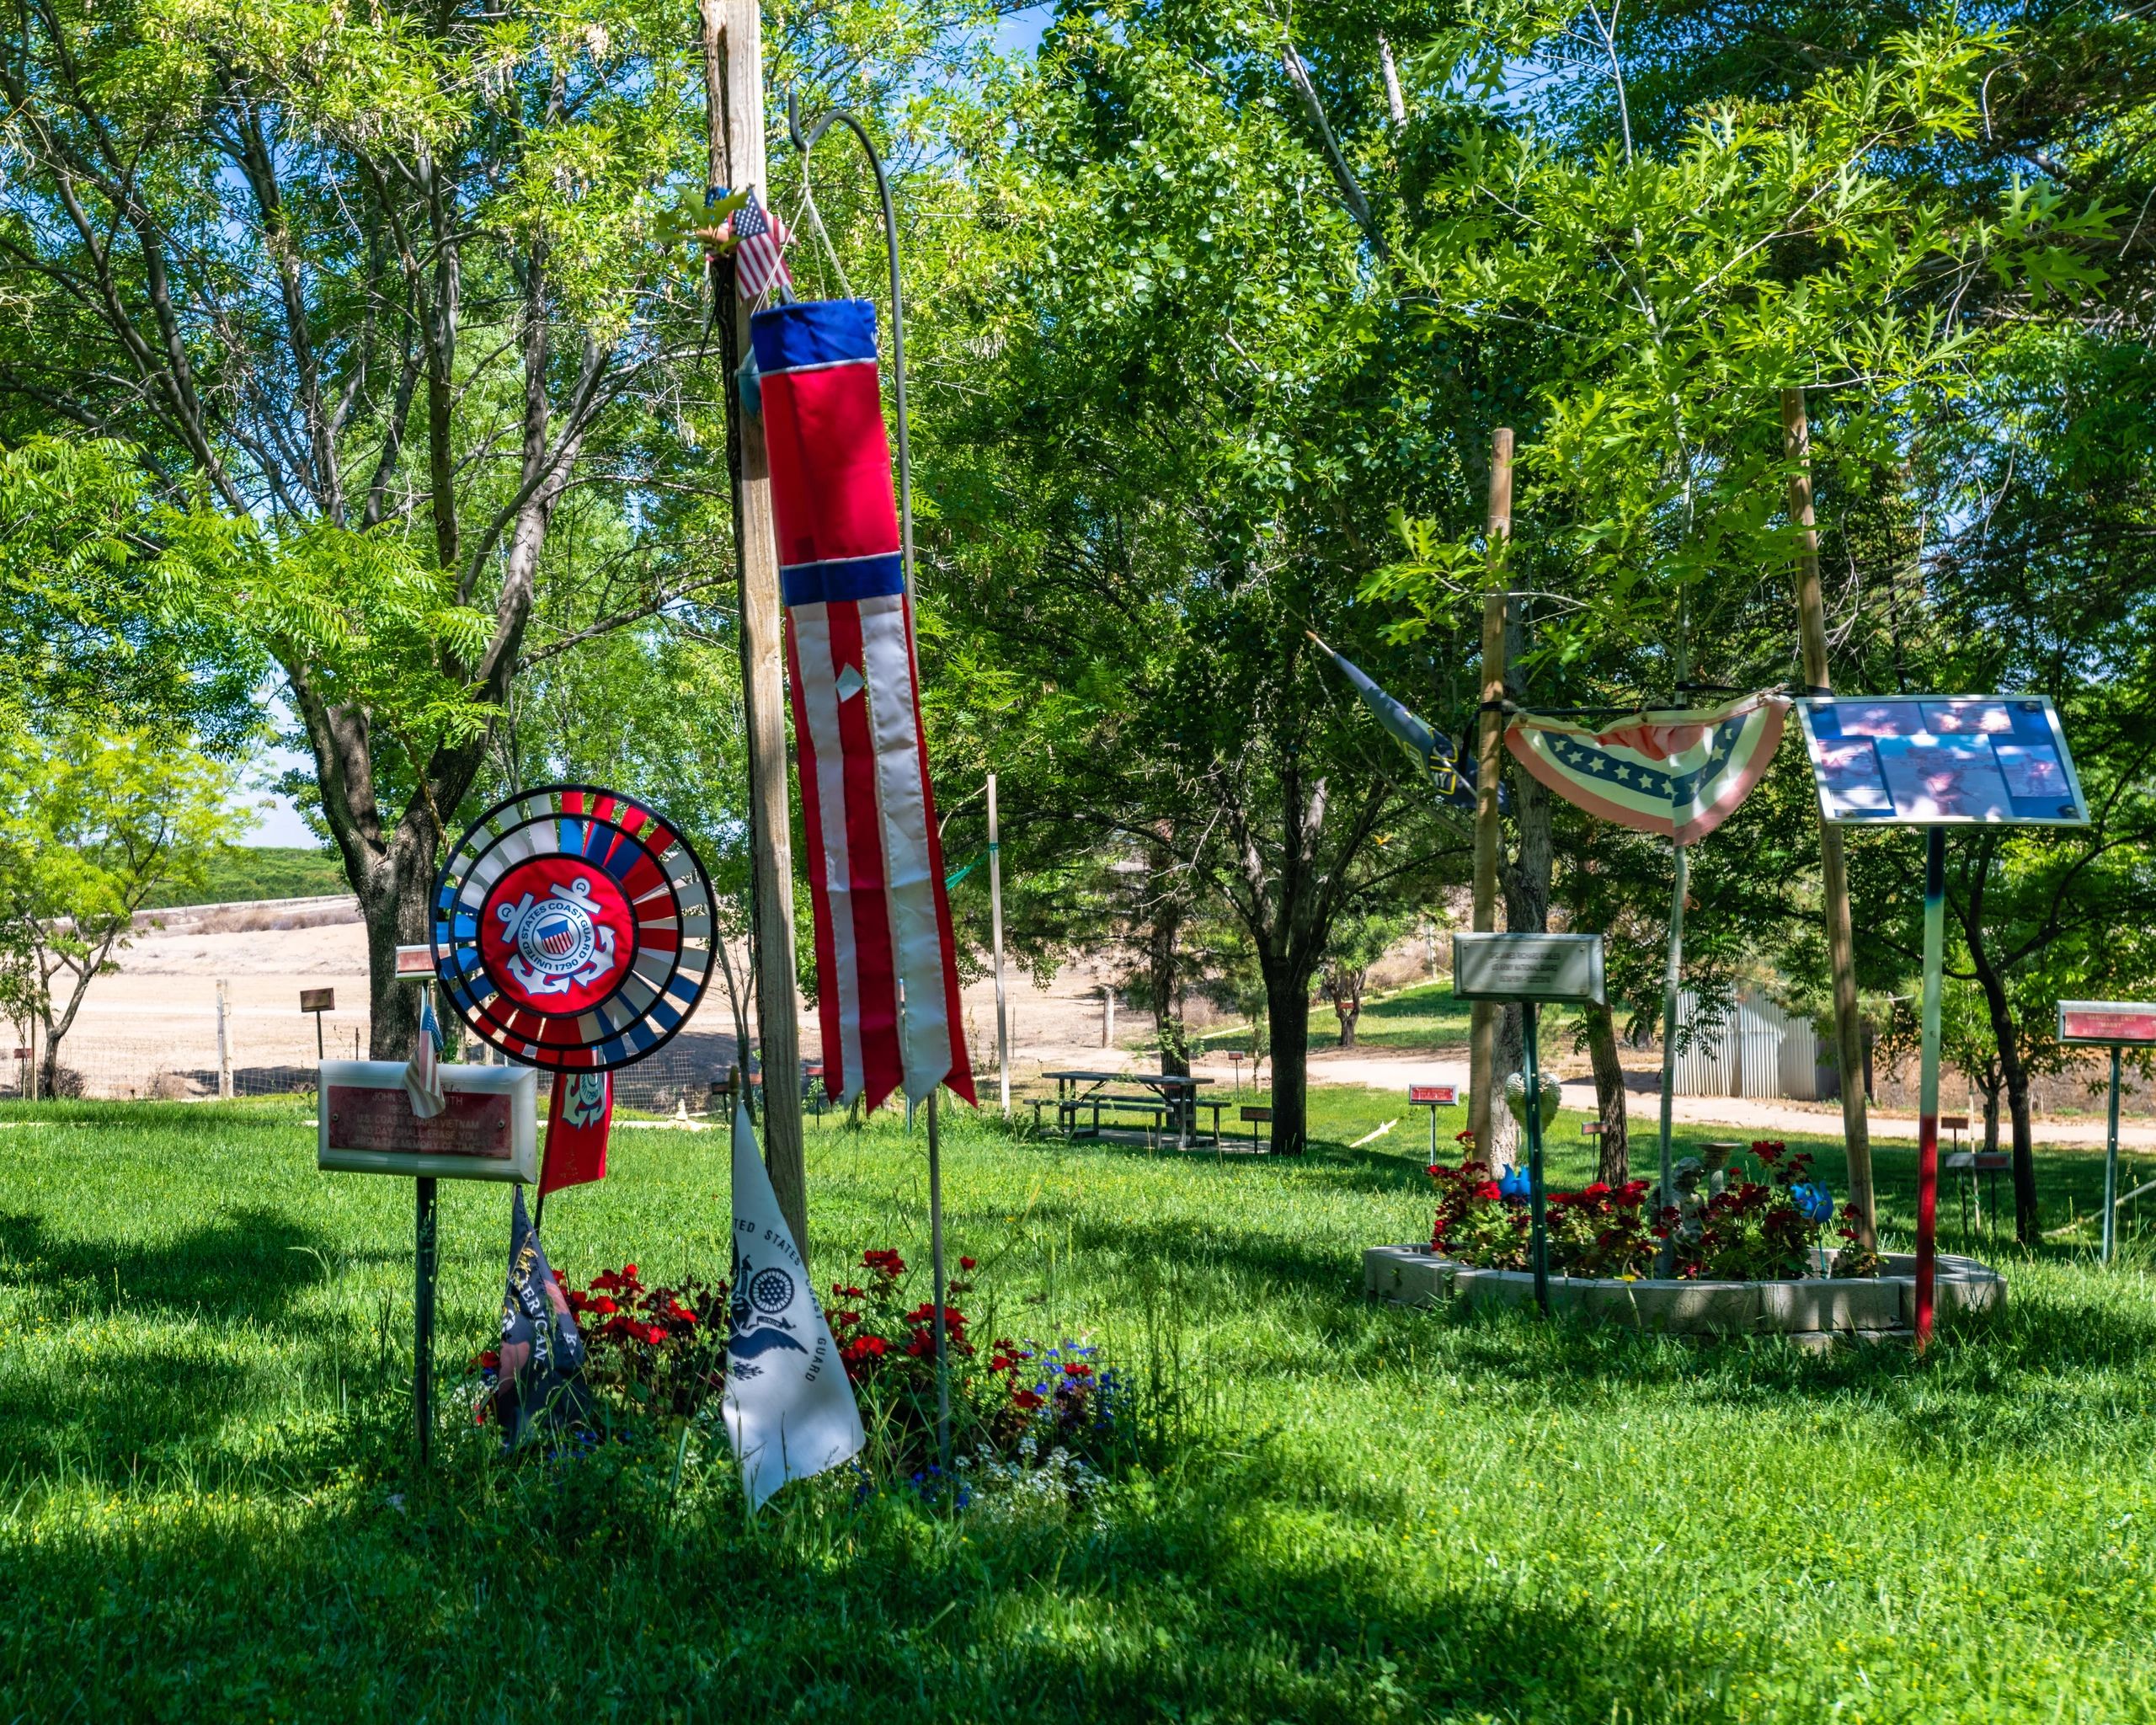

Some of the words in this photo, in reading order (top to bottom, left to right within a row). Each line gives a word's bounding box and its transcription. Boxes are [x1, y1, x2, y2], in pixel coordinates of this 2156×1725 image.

[548, 903, 583, 919] COAST
[522, 905, 547, 940] STATES
[579, 920, 591, 959] GUARD
[522, 941, 552, 970] UNITED
[555, 959, 579, 971] 1790
[372, 1092, 396, 1102] JOHN
[375, 1115, 404, 1125] COAST
[408, 1116, 437, 1127] GUARD
[440, 1119, 479, 1129] VIETNAM
[376, 1127, 394, 1136] DAY
[396, 1128, 424, 1138] SHALL
[427, 1130, 456, 1139] ERASE
[459, 1131, 478, 1140] YOU
[401, 1139, 439, 1149] MEMORY
[734, 1218, 755, 1233] TED
[764, 1229, 800, 1266] STATES
[805, 1279, 823, 1320] COAST
[805, 1338, 827, 1382] GUARD
